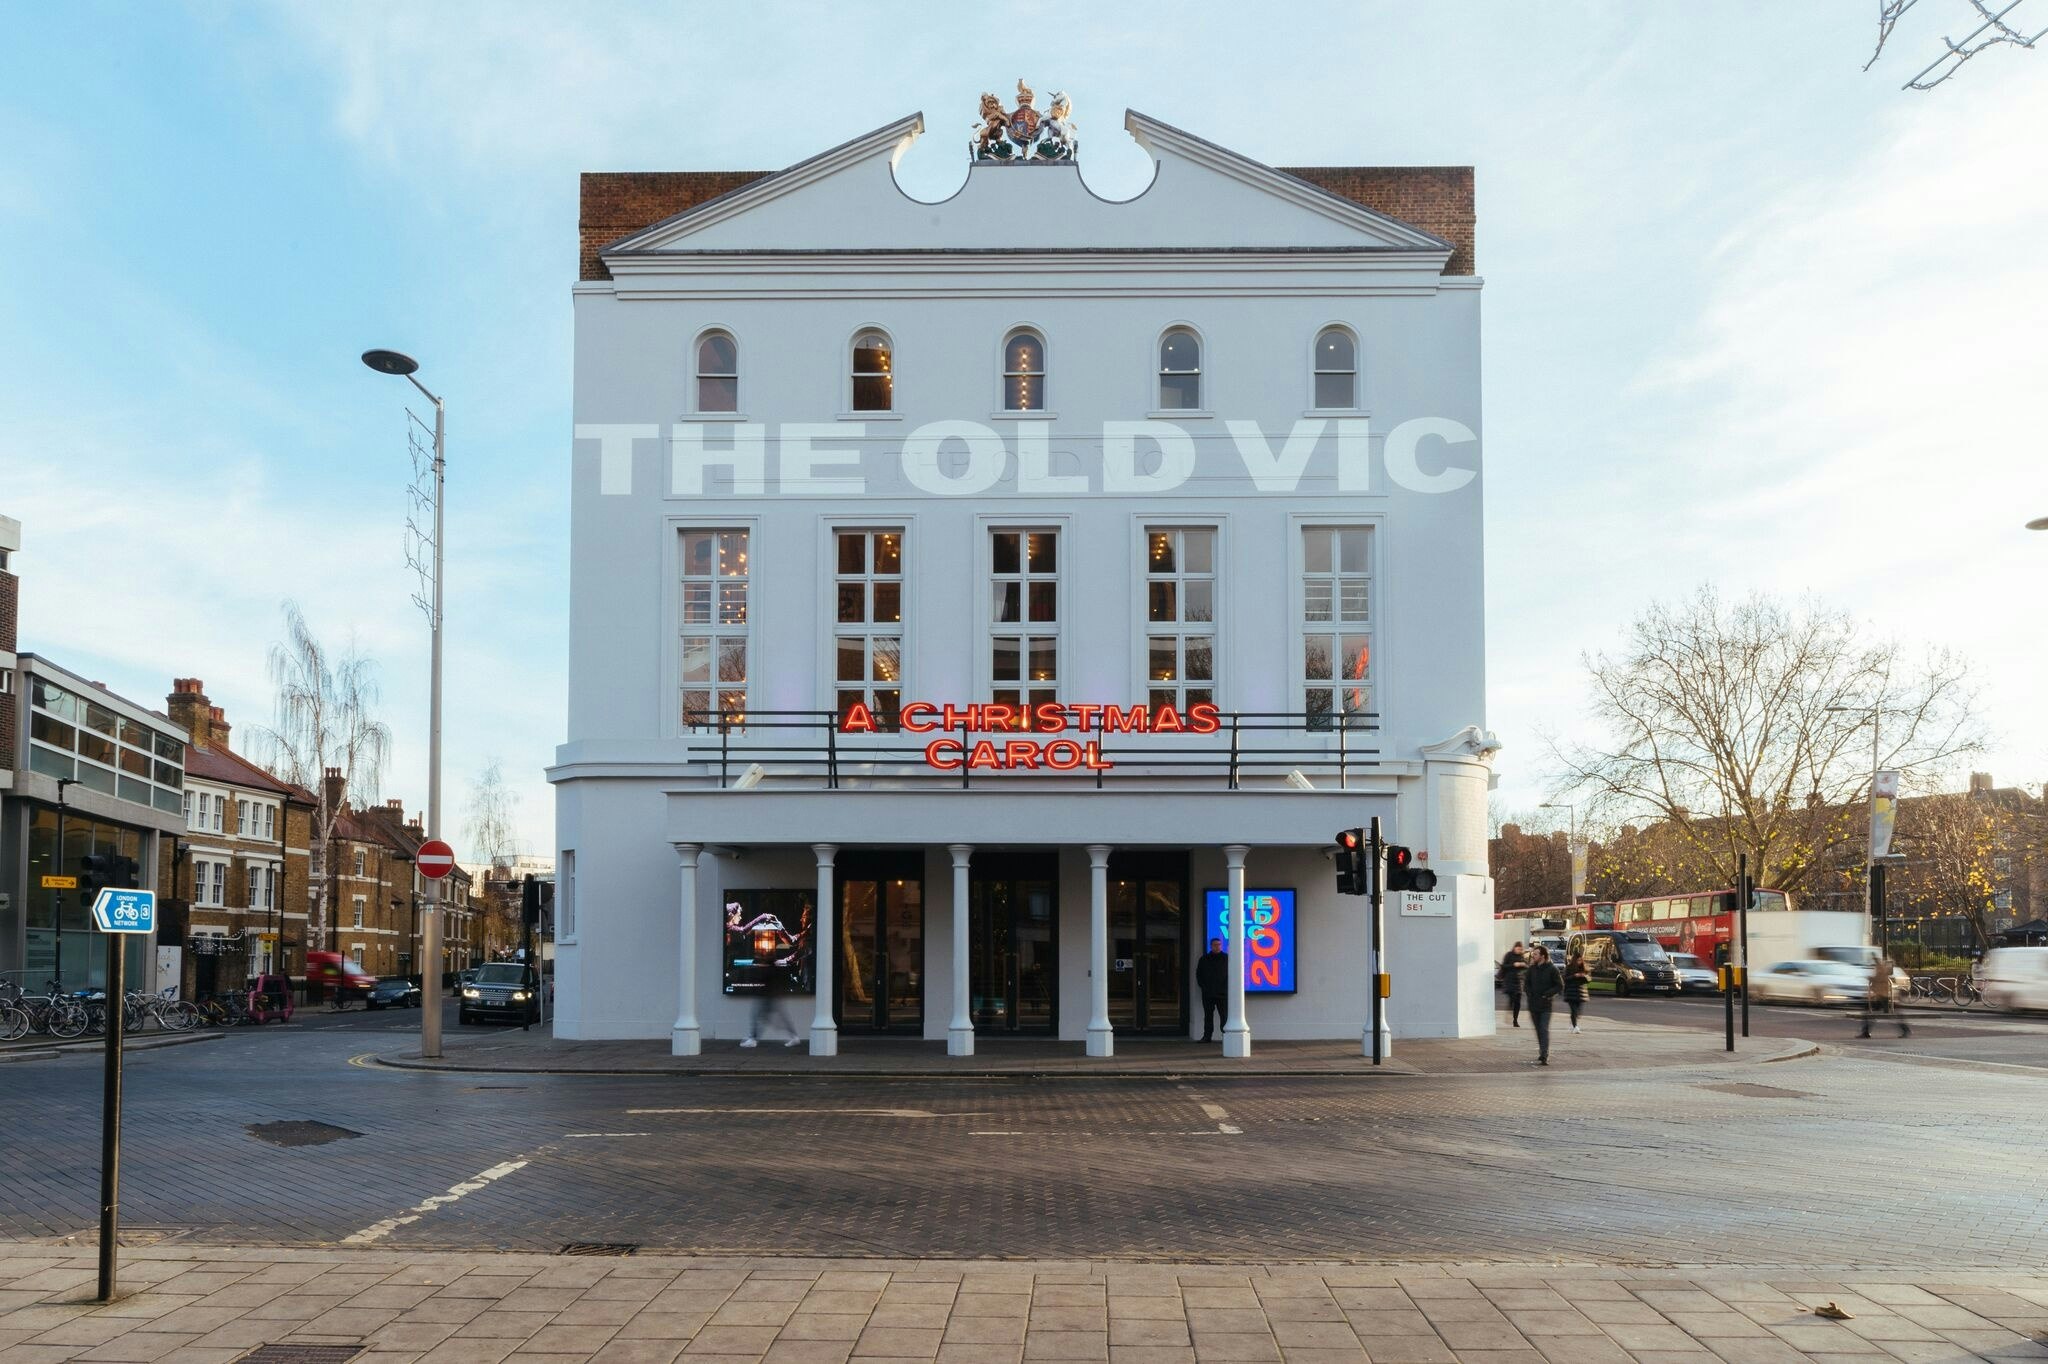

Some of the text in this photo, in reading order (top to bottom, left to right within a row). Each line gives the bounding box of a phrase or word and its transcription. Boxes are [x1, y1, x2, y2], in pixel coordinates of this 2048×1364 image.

[575, 416, 1478, 495] THE OLD VIC
[844, 702, 1222, 734] A CHRISTMAS
[925, 739, 1114, 770] CAROL
[142, 907, 148, 916] 3
[1406, 903, 1423, 911] SE1
[1220, 924, 1266, 940] VC
